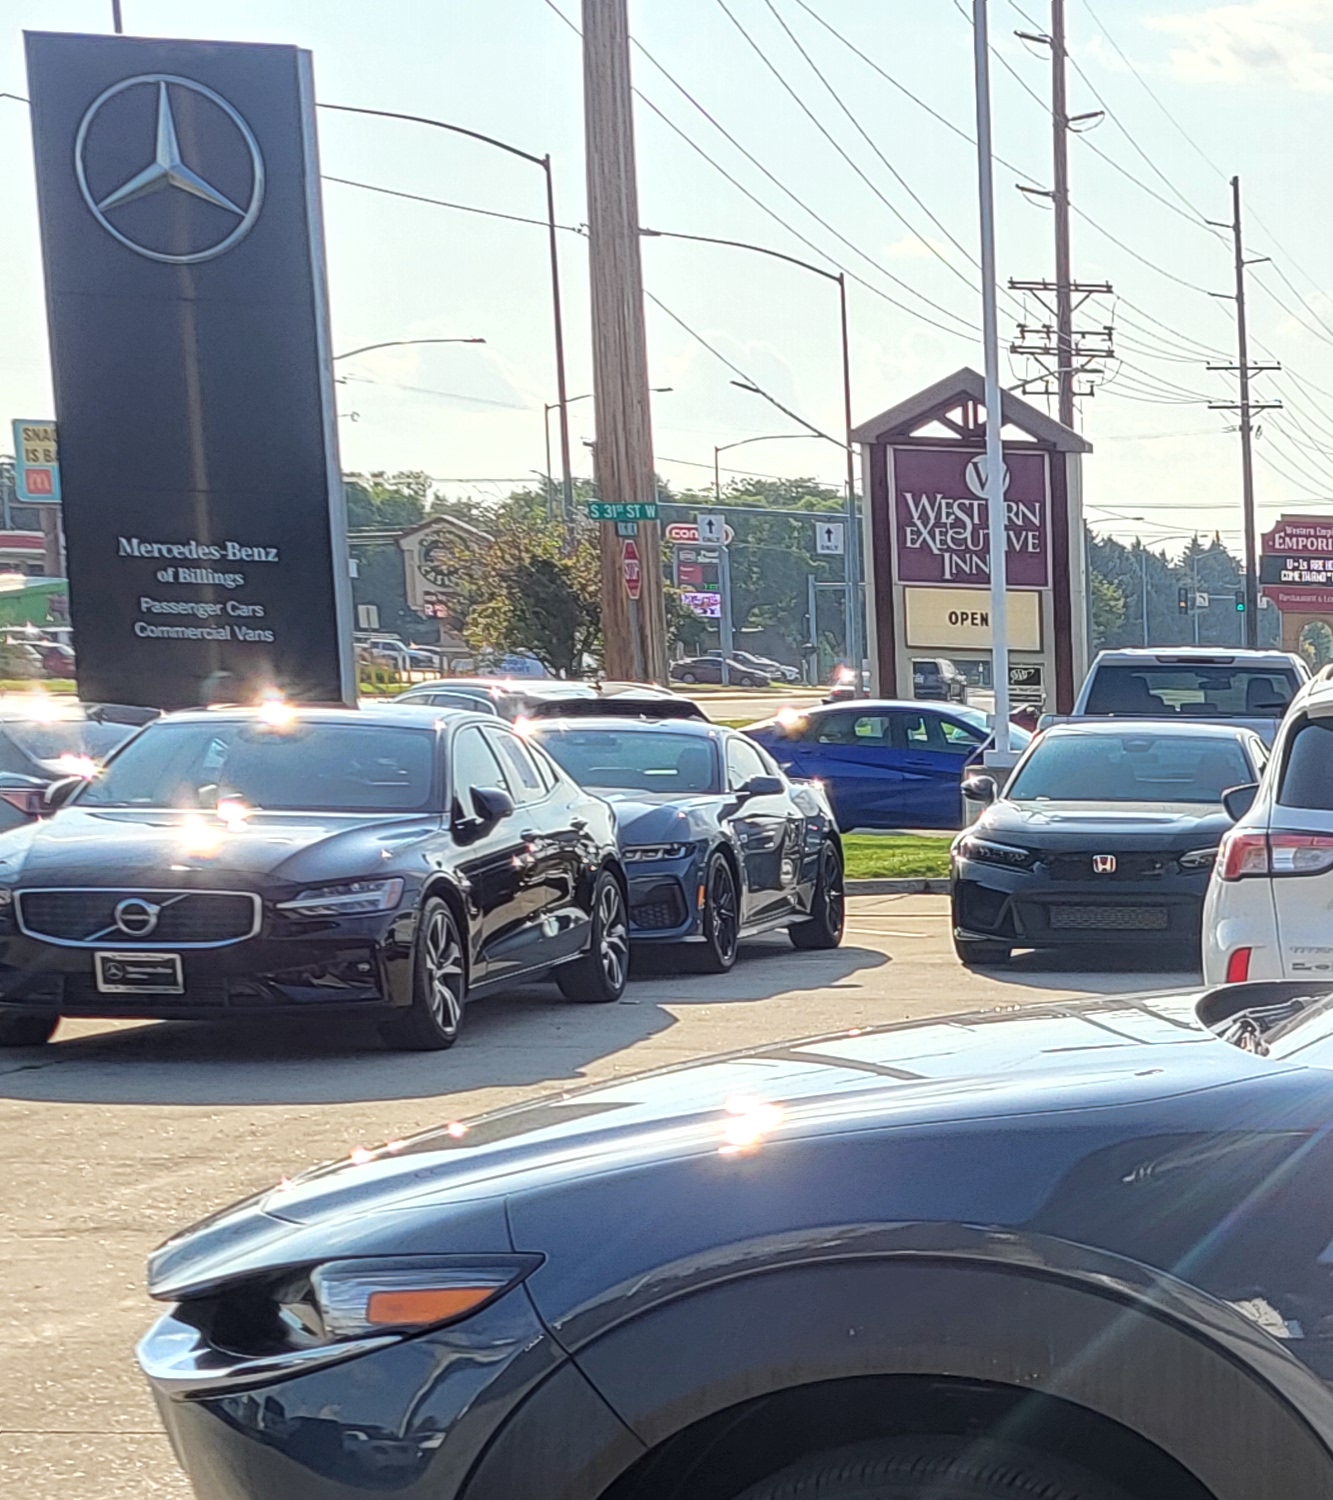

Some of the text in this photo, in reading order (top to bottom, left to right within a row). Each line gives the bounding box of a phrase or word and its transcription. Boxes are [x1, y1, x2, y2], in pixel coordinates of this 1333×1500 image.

[25, 448, 40, 463] IS
[590, 504, 599, 518] S
[626, 504, 640, 518] ST
[645, 505, 656, 518] W
[903, 493, 1040, 530] WESTRN
[905, 524, 1040, 554] EXECUIVE
[1285, 526, 1315, 536] Western
[118, 536, 279, 562] Mercedes-Benz
[942, 551, 990, 580] INN
[157, 567, 245, 588] of Billings
[140, 597, 265, 619] Passenger Cars
[948, 610, 990, 627] OPEN
[134, 622, 275, 642] Commercial Vans
